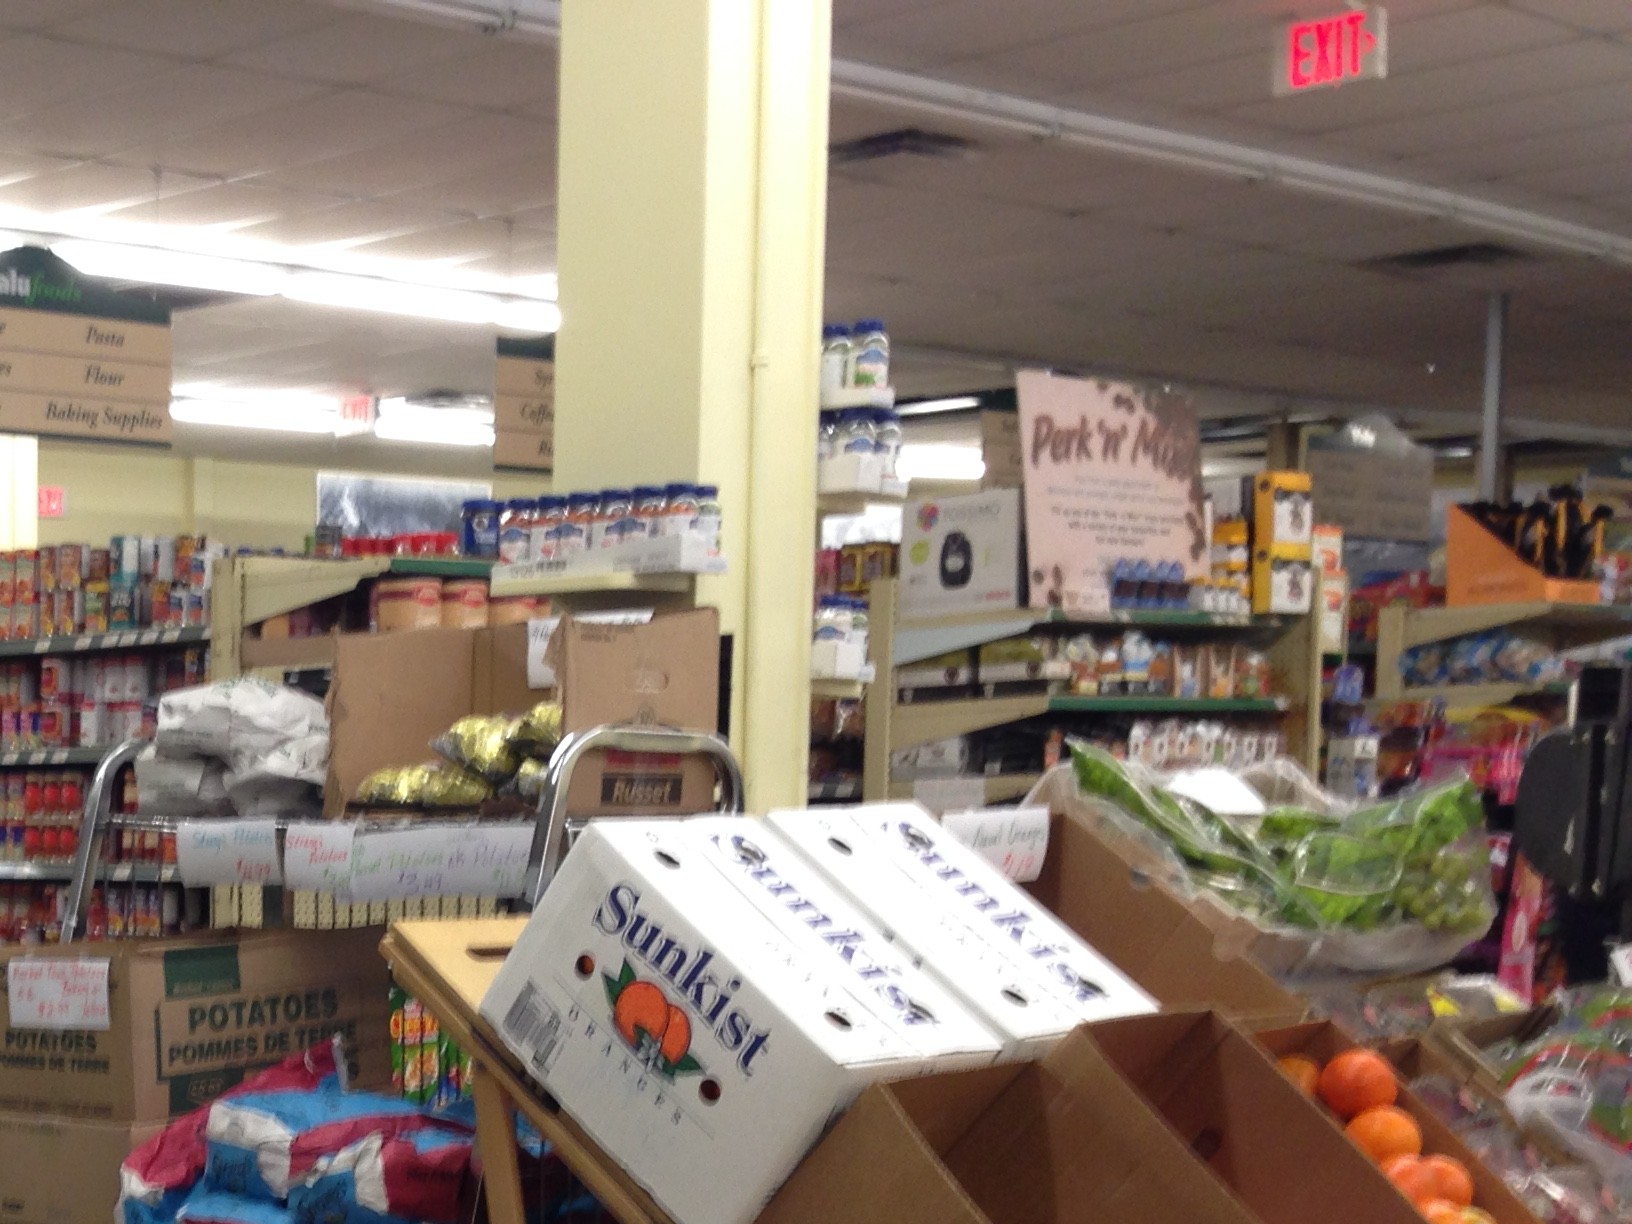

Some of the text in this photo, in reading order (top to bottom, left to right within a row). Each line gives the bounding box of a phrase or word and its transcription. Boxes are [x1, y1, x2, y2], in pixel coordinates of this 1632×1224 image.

[1288, 12, 1367, 89] EXIT
[85, 326, 125, 348] Pasta
[84, 364, 125, 386] Flour
[46, 401, 163, 432] Baking Supplies
[1032, 414, 1093, 468] Perk
[592, 880, 772, 1078] Sunkist
[188, 987, 339, 1036] POTATOES
[4, 1030, 98, 1053] POTATOES
[168, 1036, 259, 1065] POMMES
[264, 1031, 290, 1051] DE
